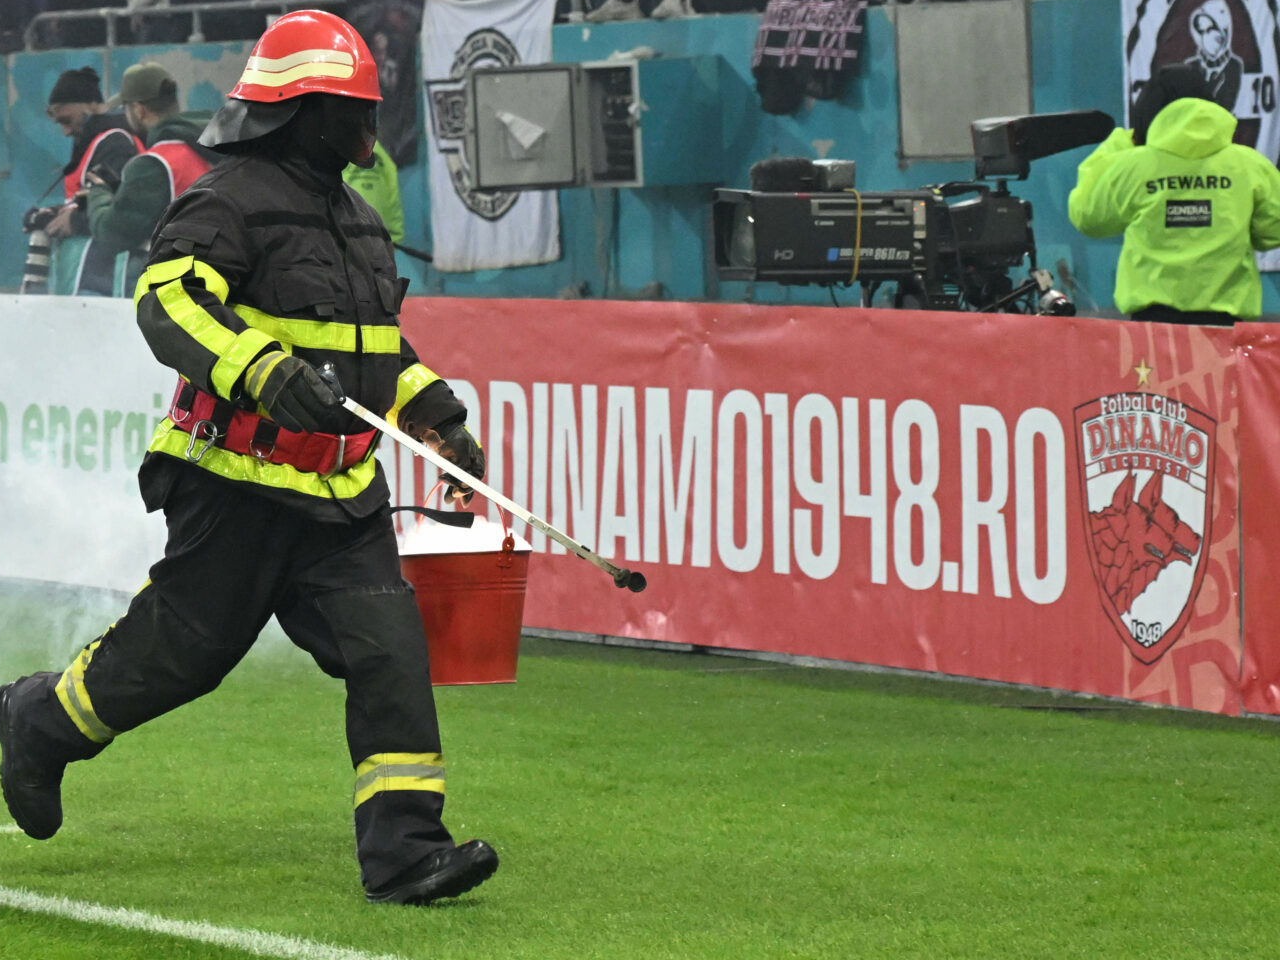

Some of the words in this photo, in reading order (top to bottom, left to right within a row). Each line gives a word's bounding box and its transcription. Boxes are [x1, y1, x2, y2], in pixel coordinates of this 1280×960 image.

[1146, 175, 1232, 194] STEWARD
[1167, 205, 1211, 216] GENERAL
[1100, 393, 1147, 414] Fotbal
[1151, 395, 1187, 422] Club
[1086, 413, 1206, 469] DINAMO
[1130, 619, 1162, 644] 1948
